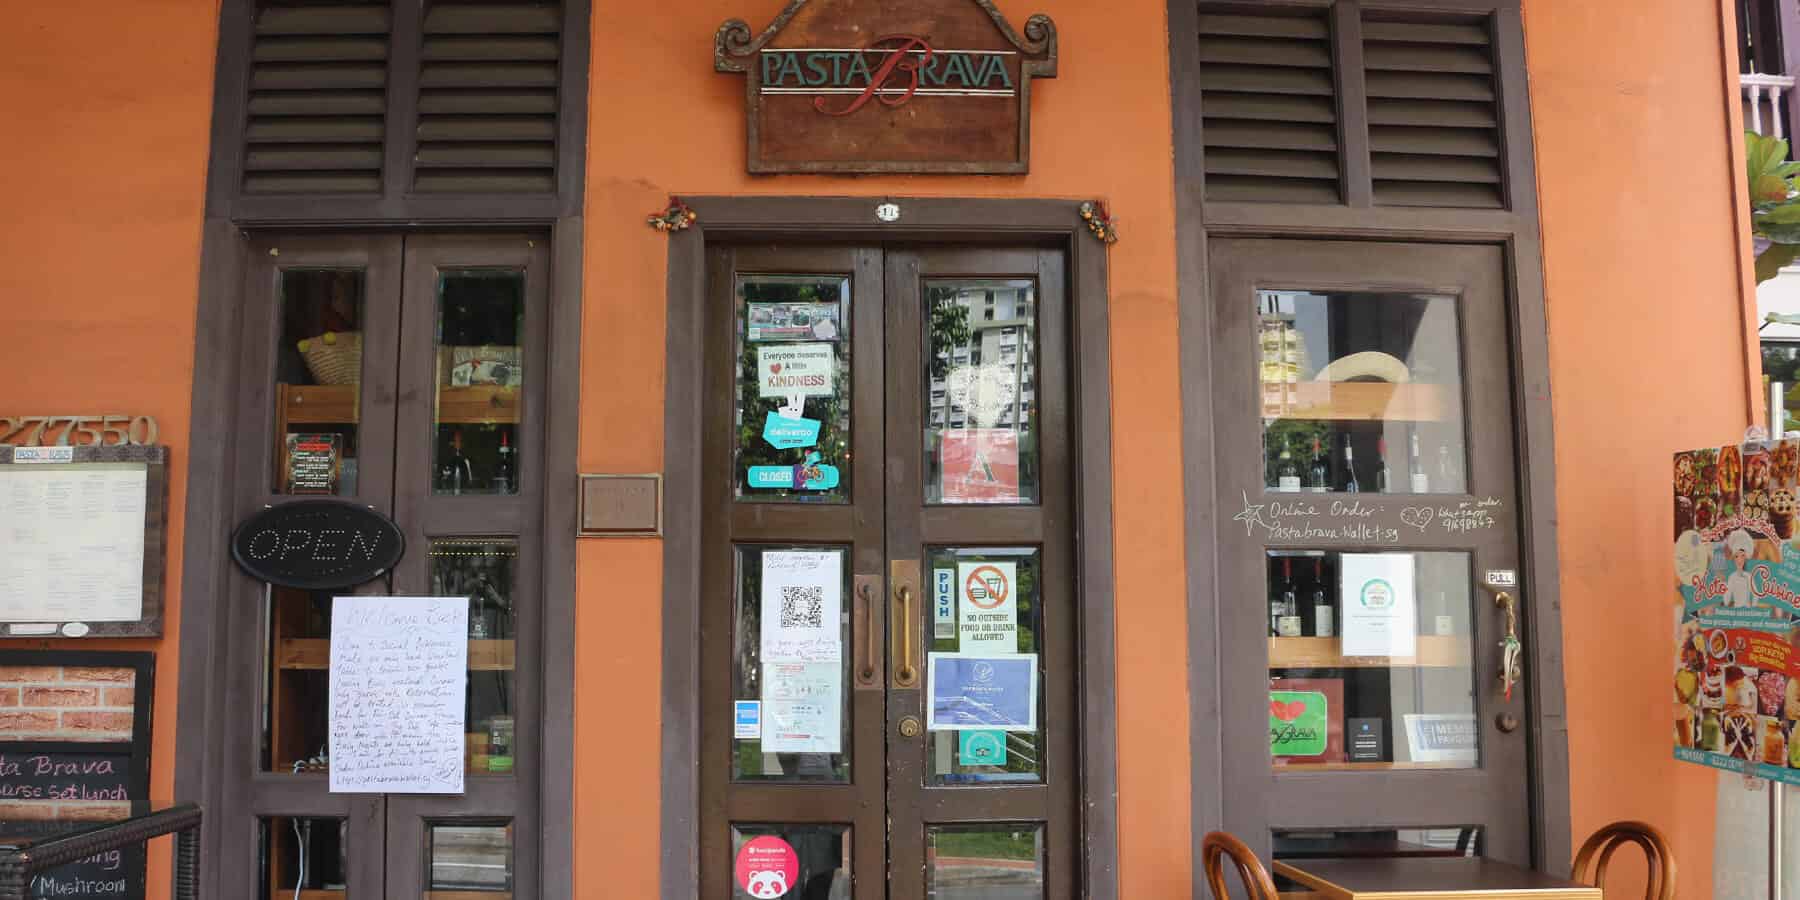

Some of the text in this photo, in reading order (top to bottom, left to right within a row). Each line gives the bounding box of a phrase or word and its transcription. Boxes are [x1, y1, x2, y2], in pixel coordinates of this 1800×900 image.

[761, 52, 873, 86] PASTA
[763, 351, 796, 361] Everyone
[767, 375, 826, 388] KINDNESS
[759, 471, 793, 482] CLOSED
[1270, 501, 1321, 519] Online
[249, 529, 383, 561] OPEN
[1489, 573, 1513, 583] PULL
[1692, 565, 1800, 608] Keto Cuisine
[939, 572, 950, 617] PUSH
[978, 613, 1008, 622] OUTSIDE
[961, 623, 980, 632] FOOD
[993, 623, 1016, 632] DRINK
[971, 633, 1005, 641] ALLOWED
[26, 755, 114, 776] Brava
